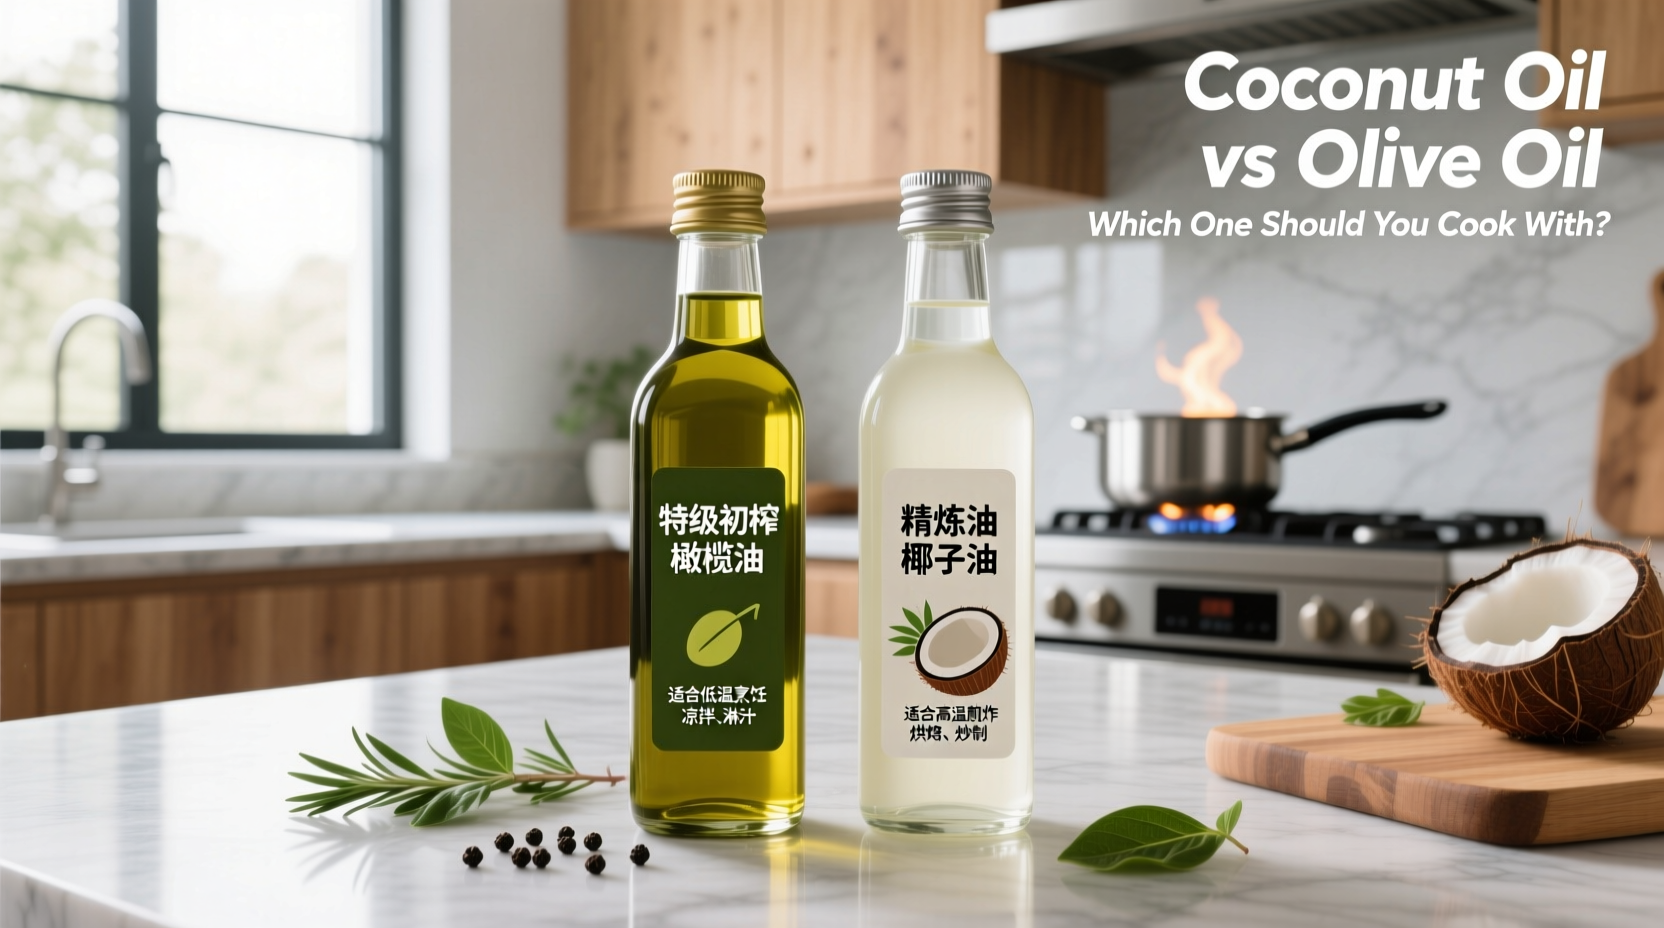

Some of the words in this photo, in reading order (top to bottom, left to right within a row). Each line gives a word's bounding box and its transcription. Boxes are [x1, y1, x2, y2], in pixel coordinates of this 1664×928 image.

[658, 502, 780, 536] 特级初榨
[900, 503, 998, 538] 精炼油
[670, 541, 764, 575] 橄榄油
[900, 542, 998, 576] 椰子油
